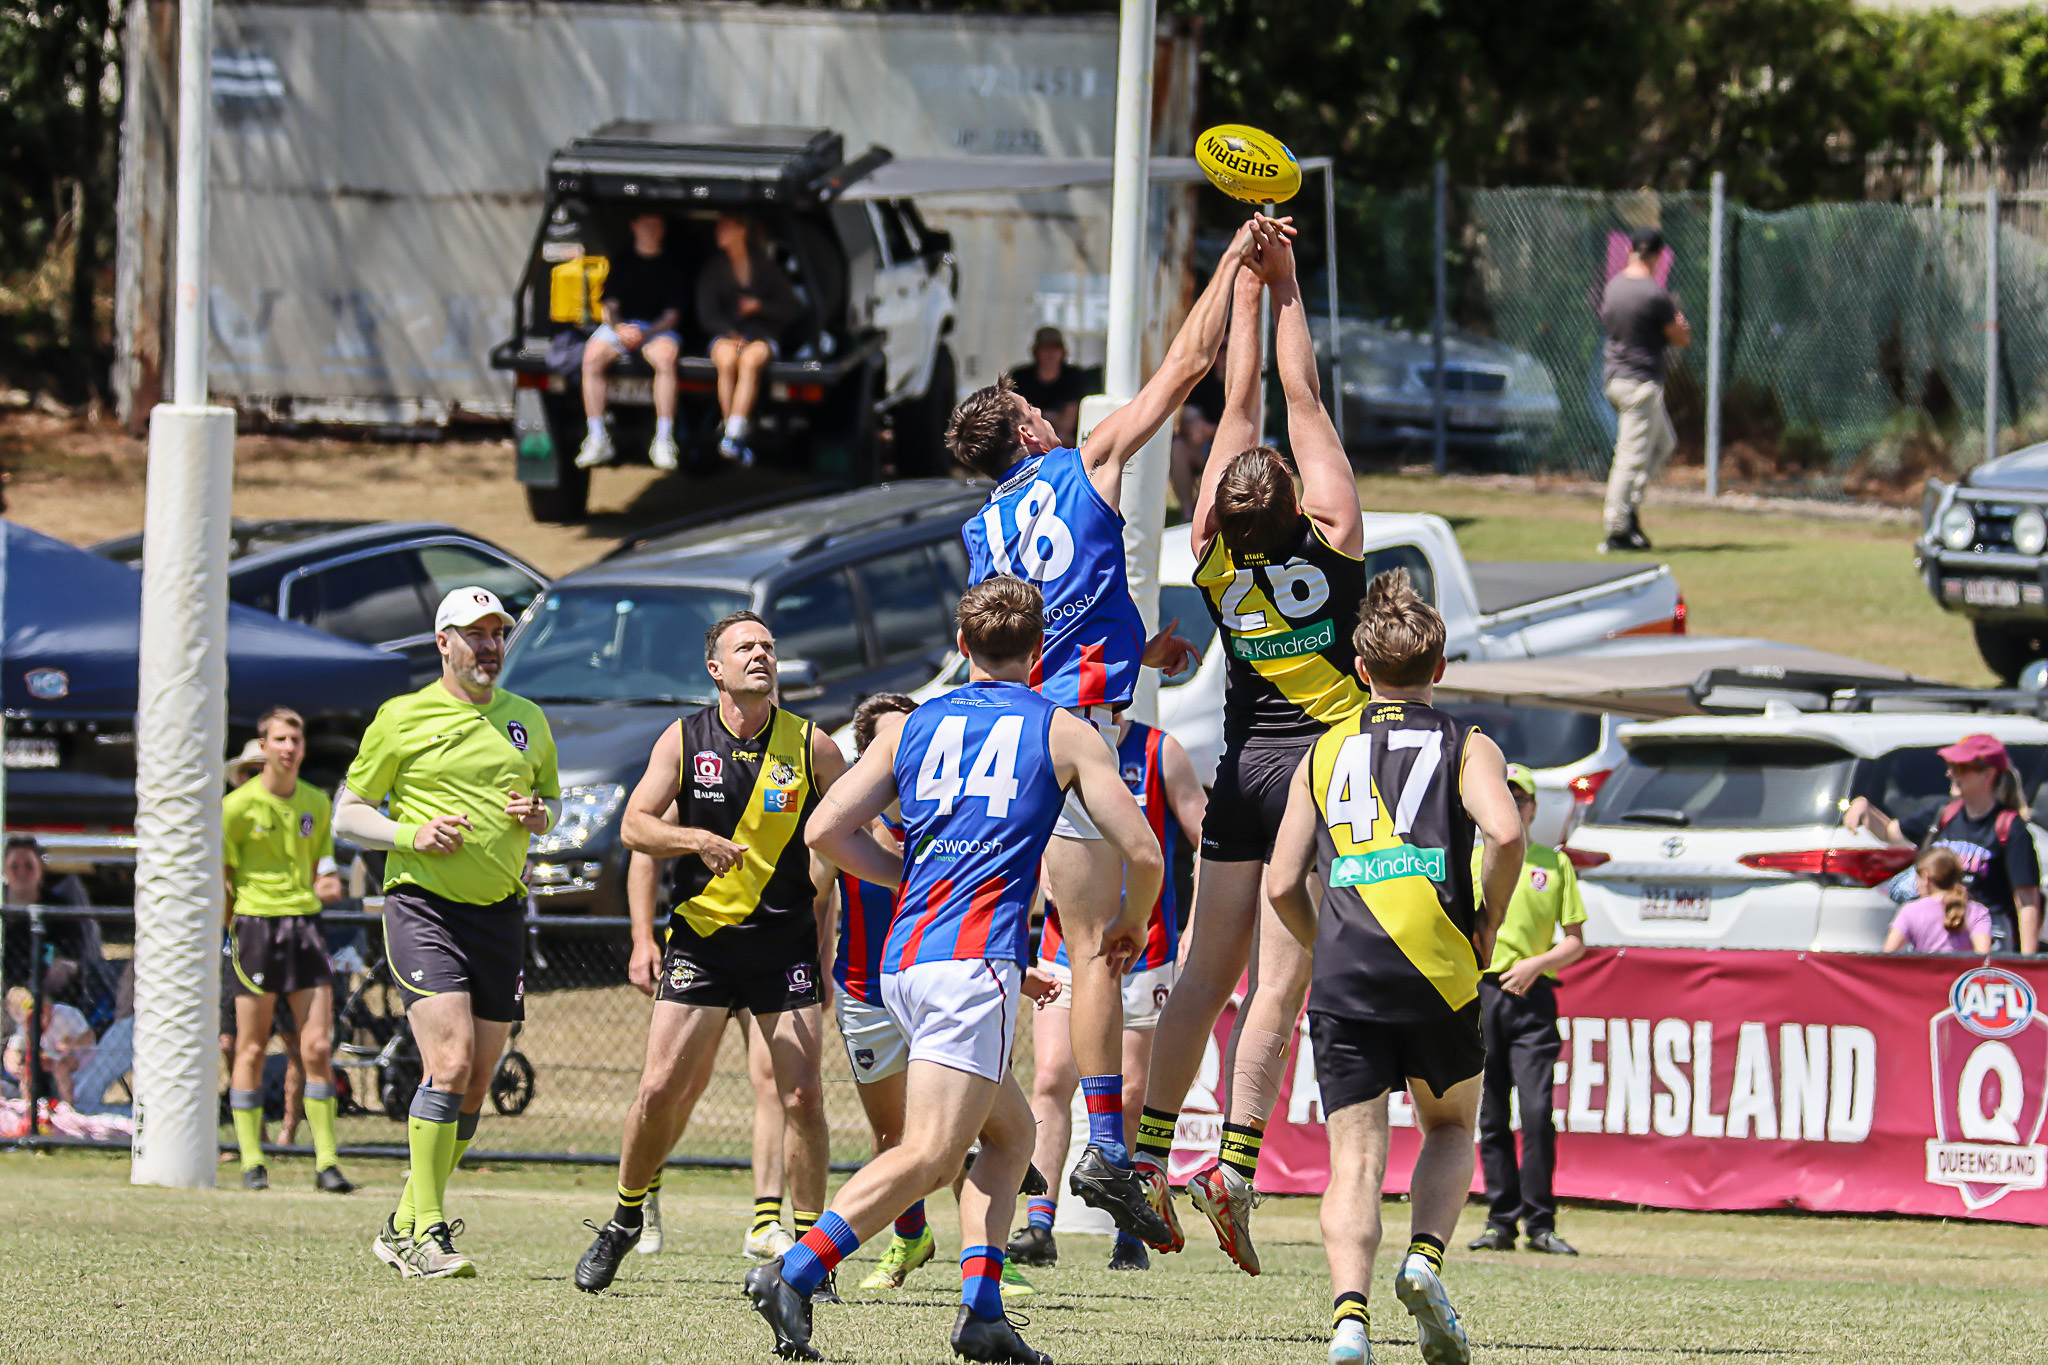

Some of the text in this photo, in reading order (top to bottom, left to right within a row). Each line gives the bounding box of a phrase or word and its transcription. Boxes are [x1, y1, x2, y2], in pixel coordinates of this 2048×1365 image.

[1203, 136, 1279, 178] SHERRIN
[983, 479, 1075, 582] 18
[1220, 556, 1330, 632] 26
[1254, 626, 1332, 658] Kindred
[1371, 714, 1386, 723] EST
[700, 761, 716, 777] Q
[915, 715, 1025, 819] 44
[701, 791, 725, 799] ALPHA
[1326, 729, 1444, 844] 47
[934, 838, 1003, 855] swoosh
[934, 854, 957, 863] finance
[1365, 852, 1440, 881] Kindred
[793, 969, 806, 984] Q
[1960, 982, 2028, 1020] AFL
[1958, 1040, 2025, 1144] Q
[1938, 1151, 2036, 1176] QUEENSLAND
